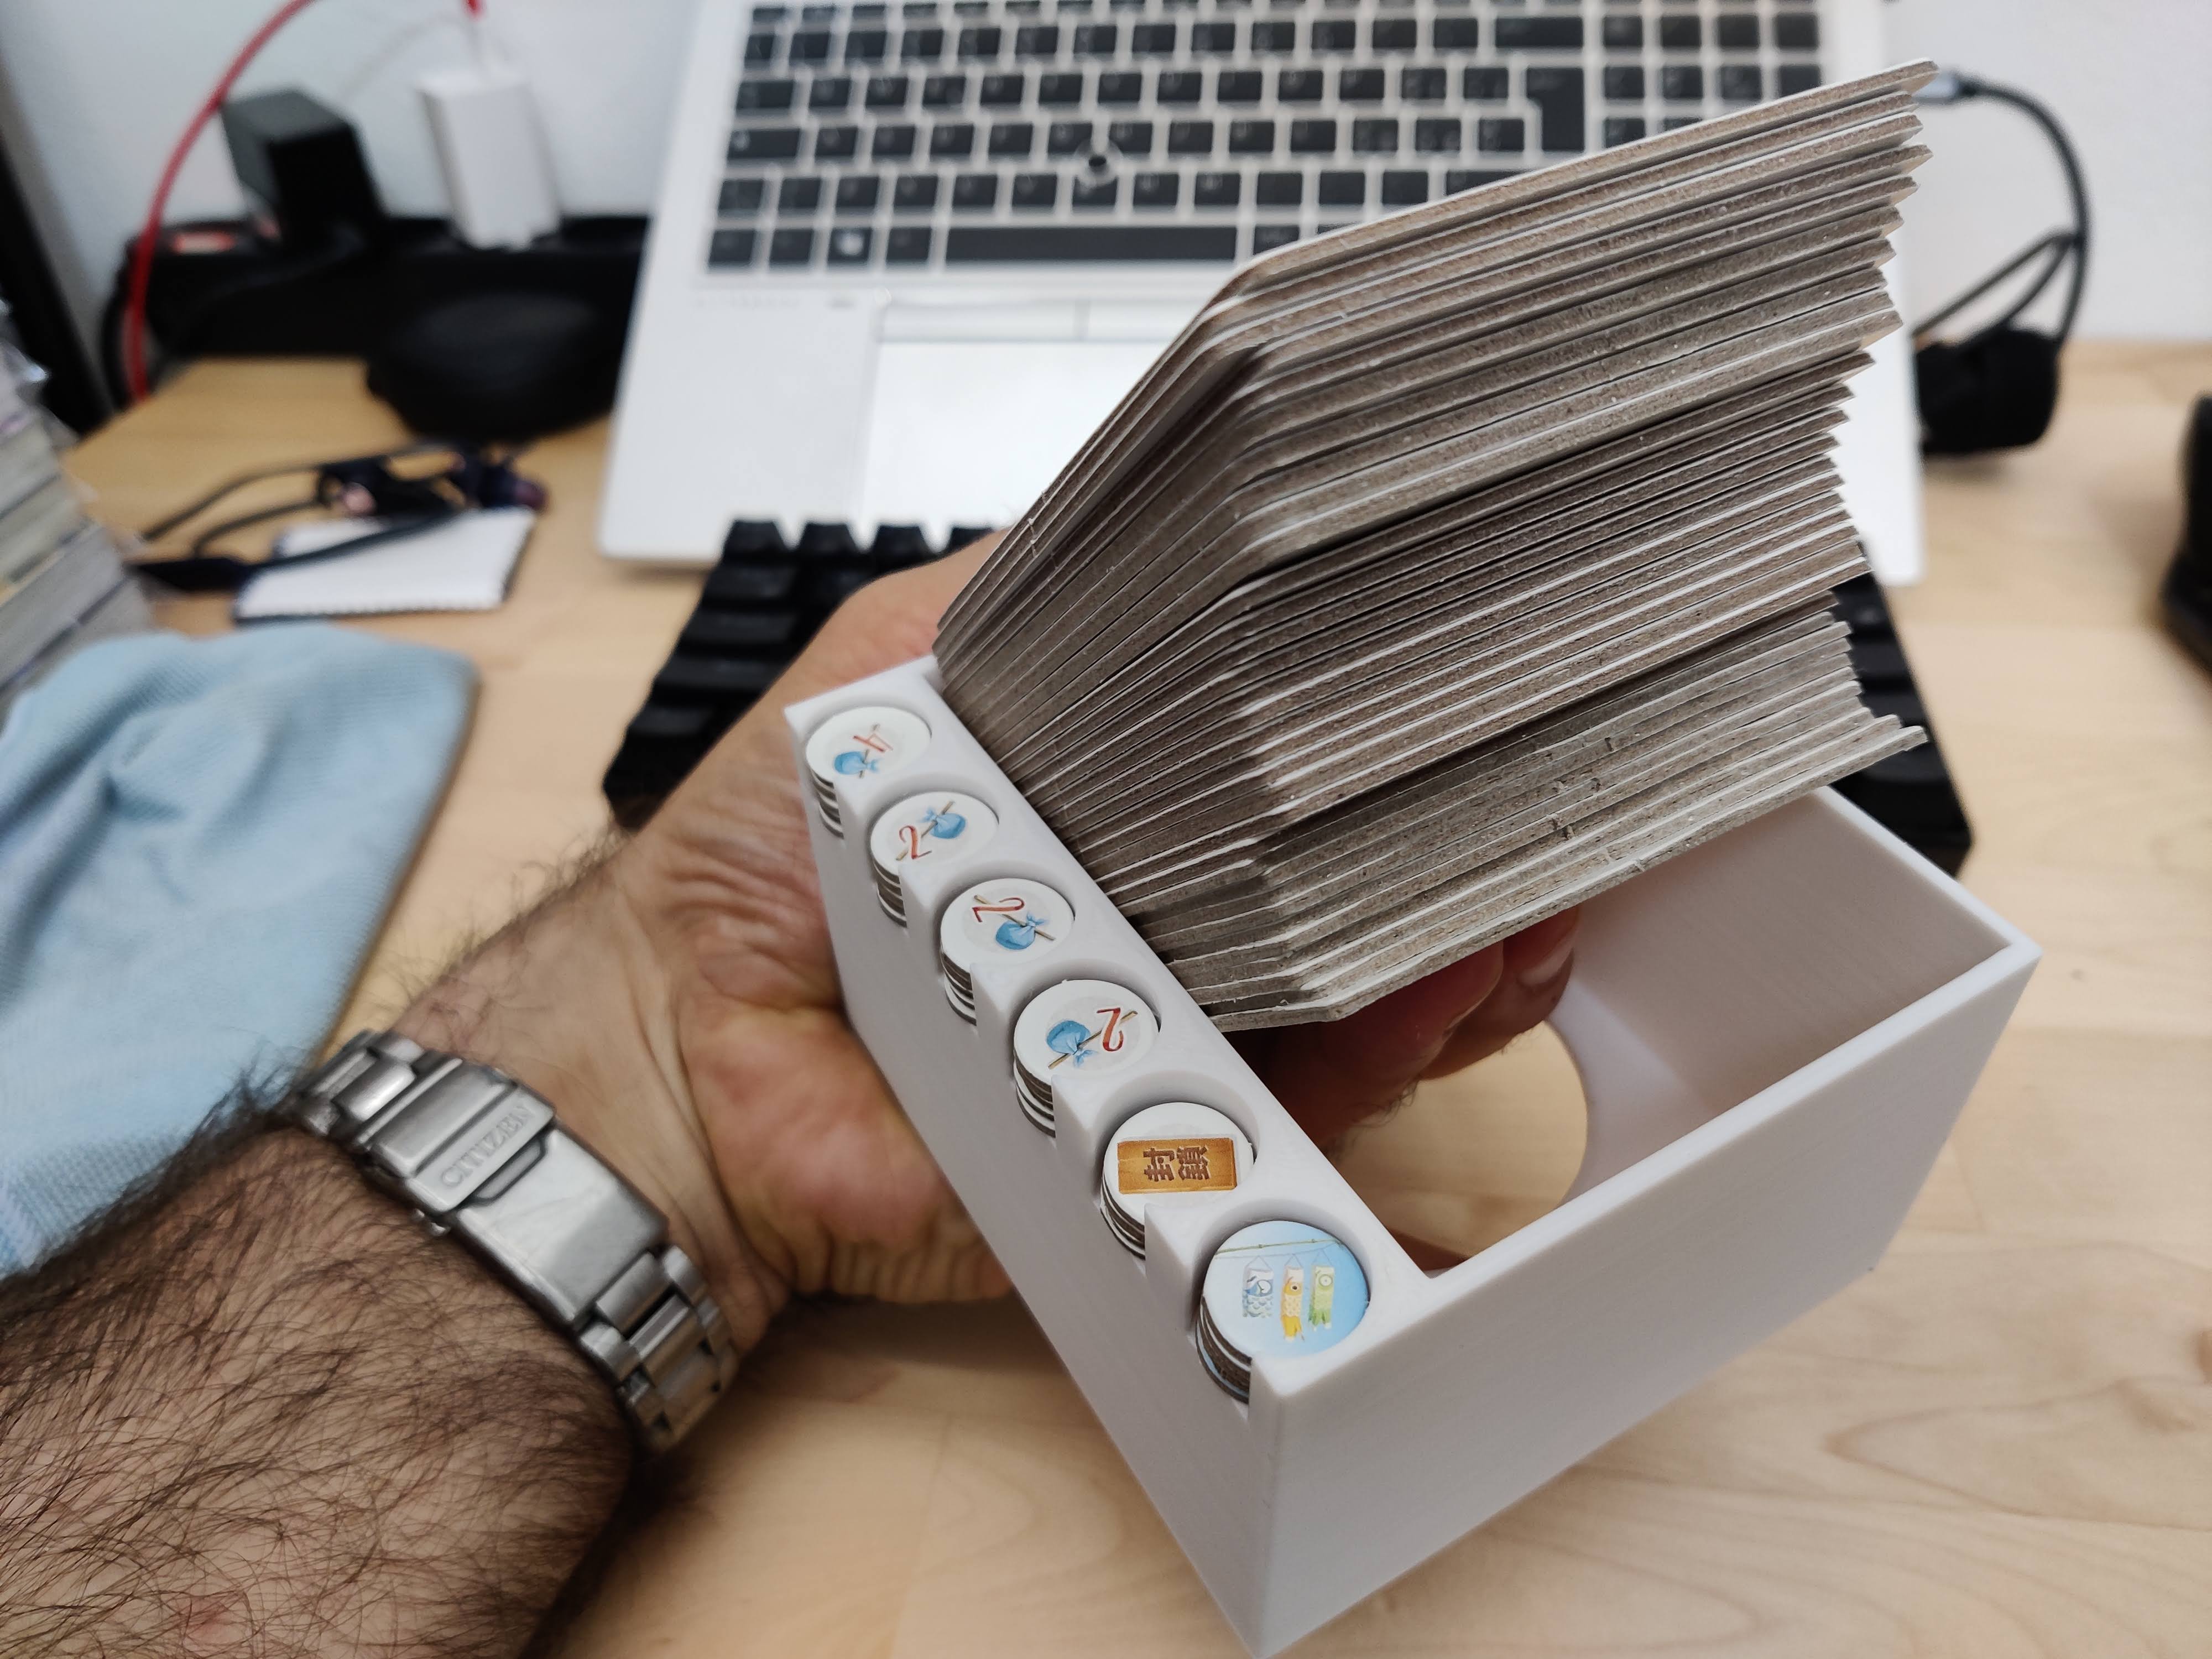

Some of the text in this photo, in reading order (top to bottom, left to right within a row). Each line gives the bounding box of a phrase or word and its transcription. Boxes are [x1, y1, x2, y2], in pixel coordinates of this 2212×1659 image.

[899, 825, 932, 860] 2
[972, 897, 1025, 922] 2
[1097, 1007, 1124, 1052] 2
[441, 1105, 533, 1187] CITIZEN
[1143, 1146, 1209, 1182] 封鎖
